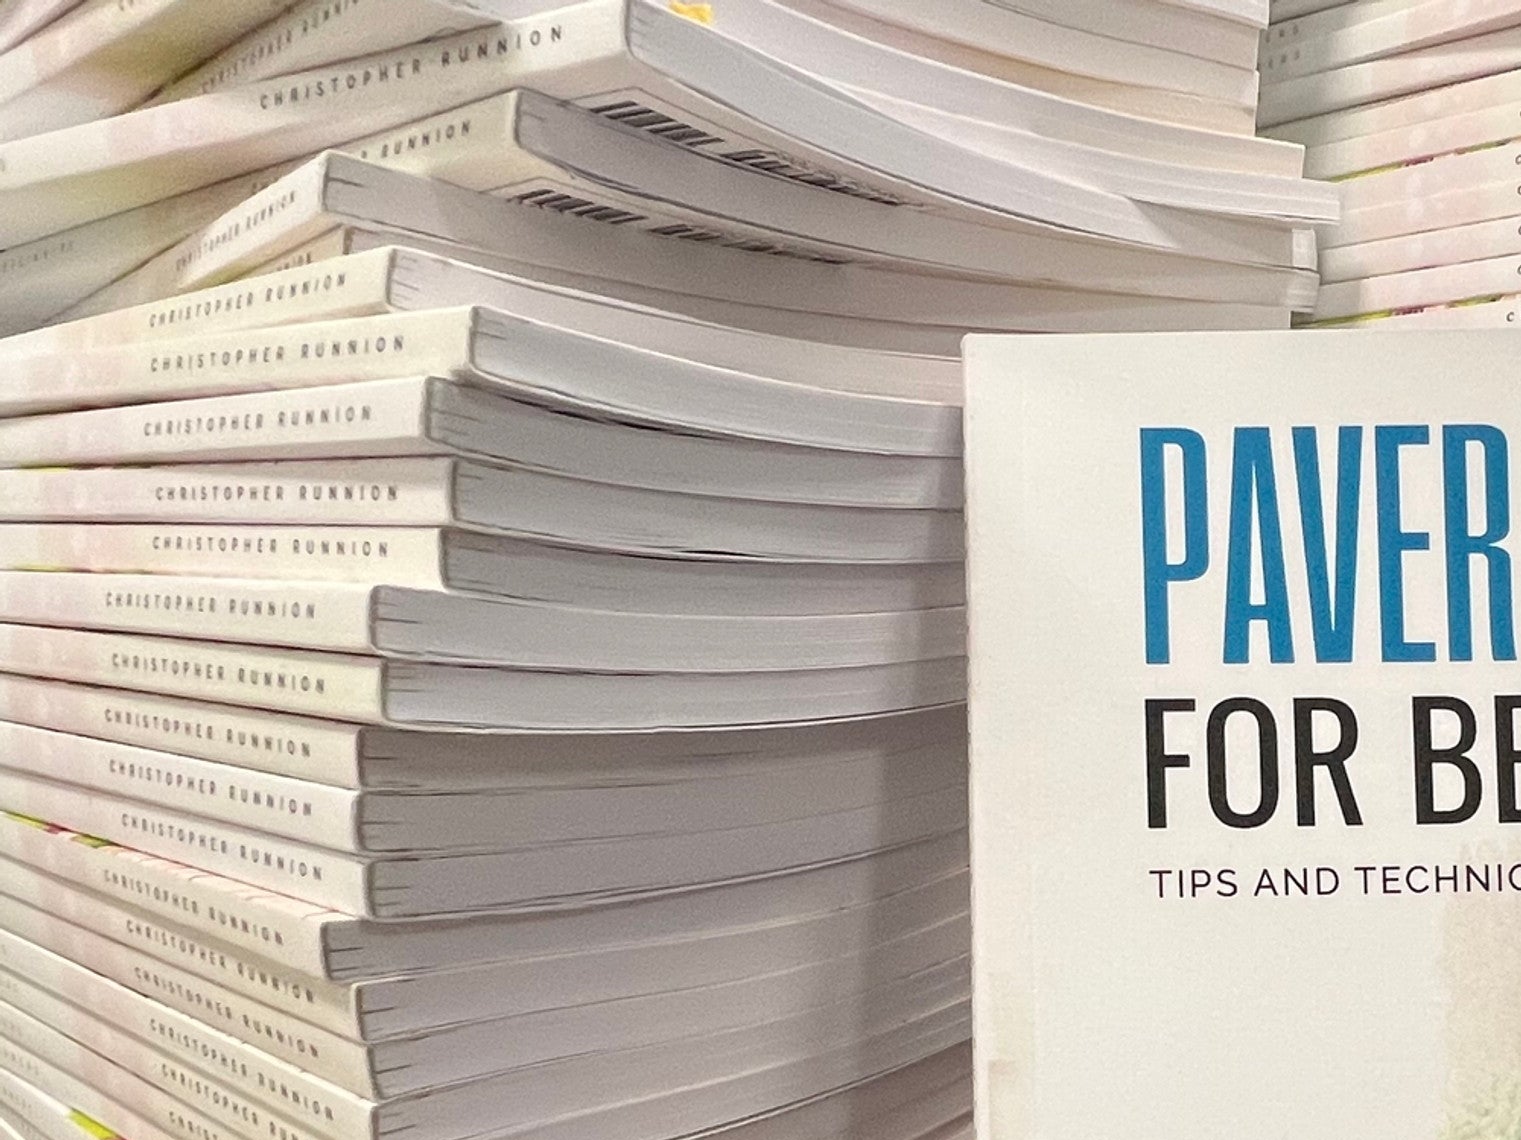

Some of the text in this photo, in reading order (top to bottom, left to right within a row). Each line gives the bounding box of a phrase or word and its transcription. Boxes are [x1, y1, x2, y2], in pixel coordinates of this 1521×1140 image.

[260, 25, 562, 109] CHRISTOPHER RUNNION
[381, 120, 471, 158] RUNNION
[149, 273, 345, 328] CHRISTOPHER RUNNION
[151, 335, 403, 372] CHRISTOPHER RUNNION
[144, 405, 371, 436] CHRISTOPHER RUNNION
[156, 486, 398, 501] CHRISTOPHER RUNNION
[153, 536, 388, 557] CHRISTOPHER RUNNION
[1139, 424, 1518, 665] PAVER
[106, 592, 315, 619] CHRISTOPHER RUNNION
[112, 653, 325, 694] CHRISTOPHER RUNNION
[105, 709, 311, 757] CHRISTOPHER RUNNION
[109, 759, 312, 816] CHRISTOPHER RUNNION
[1144, 696, 1364, 829] FOR
[121, 813, 322, 881] CHRISTOPHER RUNNION
[104, 869, 283, 945] CHRISTOPHER RUNNION
[1148, 869, 1239, 899] TIPS
[1253, 867, 1340, 897] AND
[127, 920, 315, 1002] CHRISTOPHER RUNNION
[134, 966, 319, 1058] CHRISTOPHER RUNNION
[150, 1018, 333, 1121] CHRISTOPHER RUNNION
[161, 1063, 258, 1126] CHRISTOPHER
